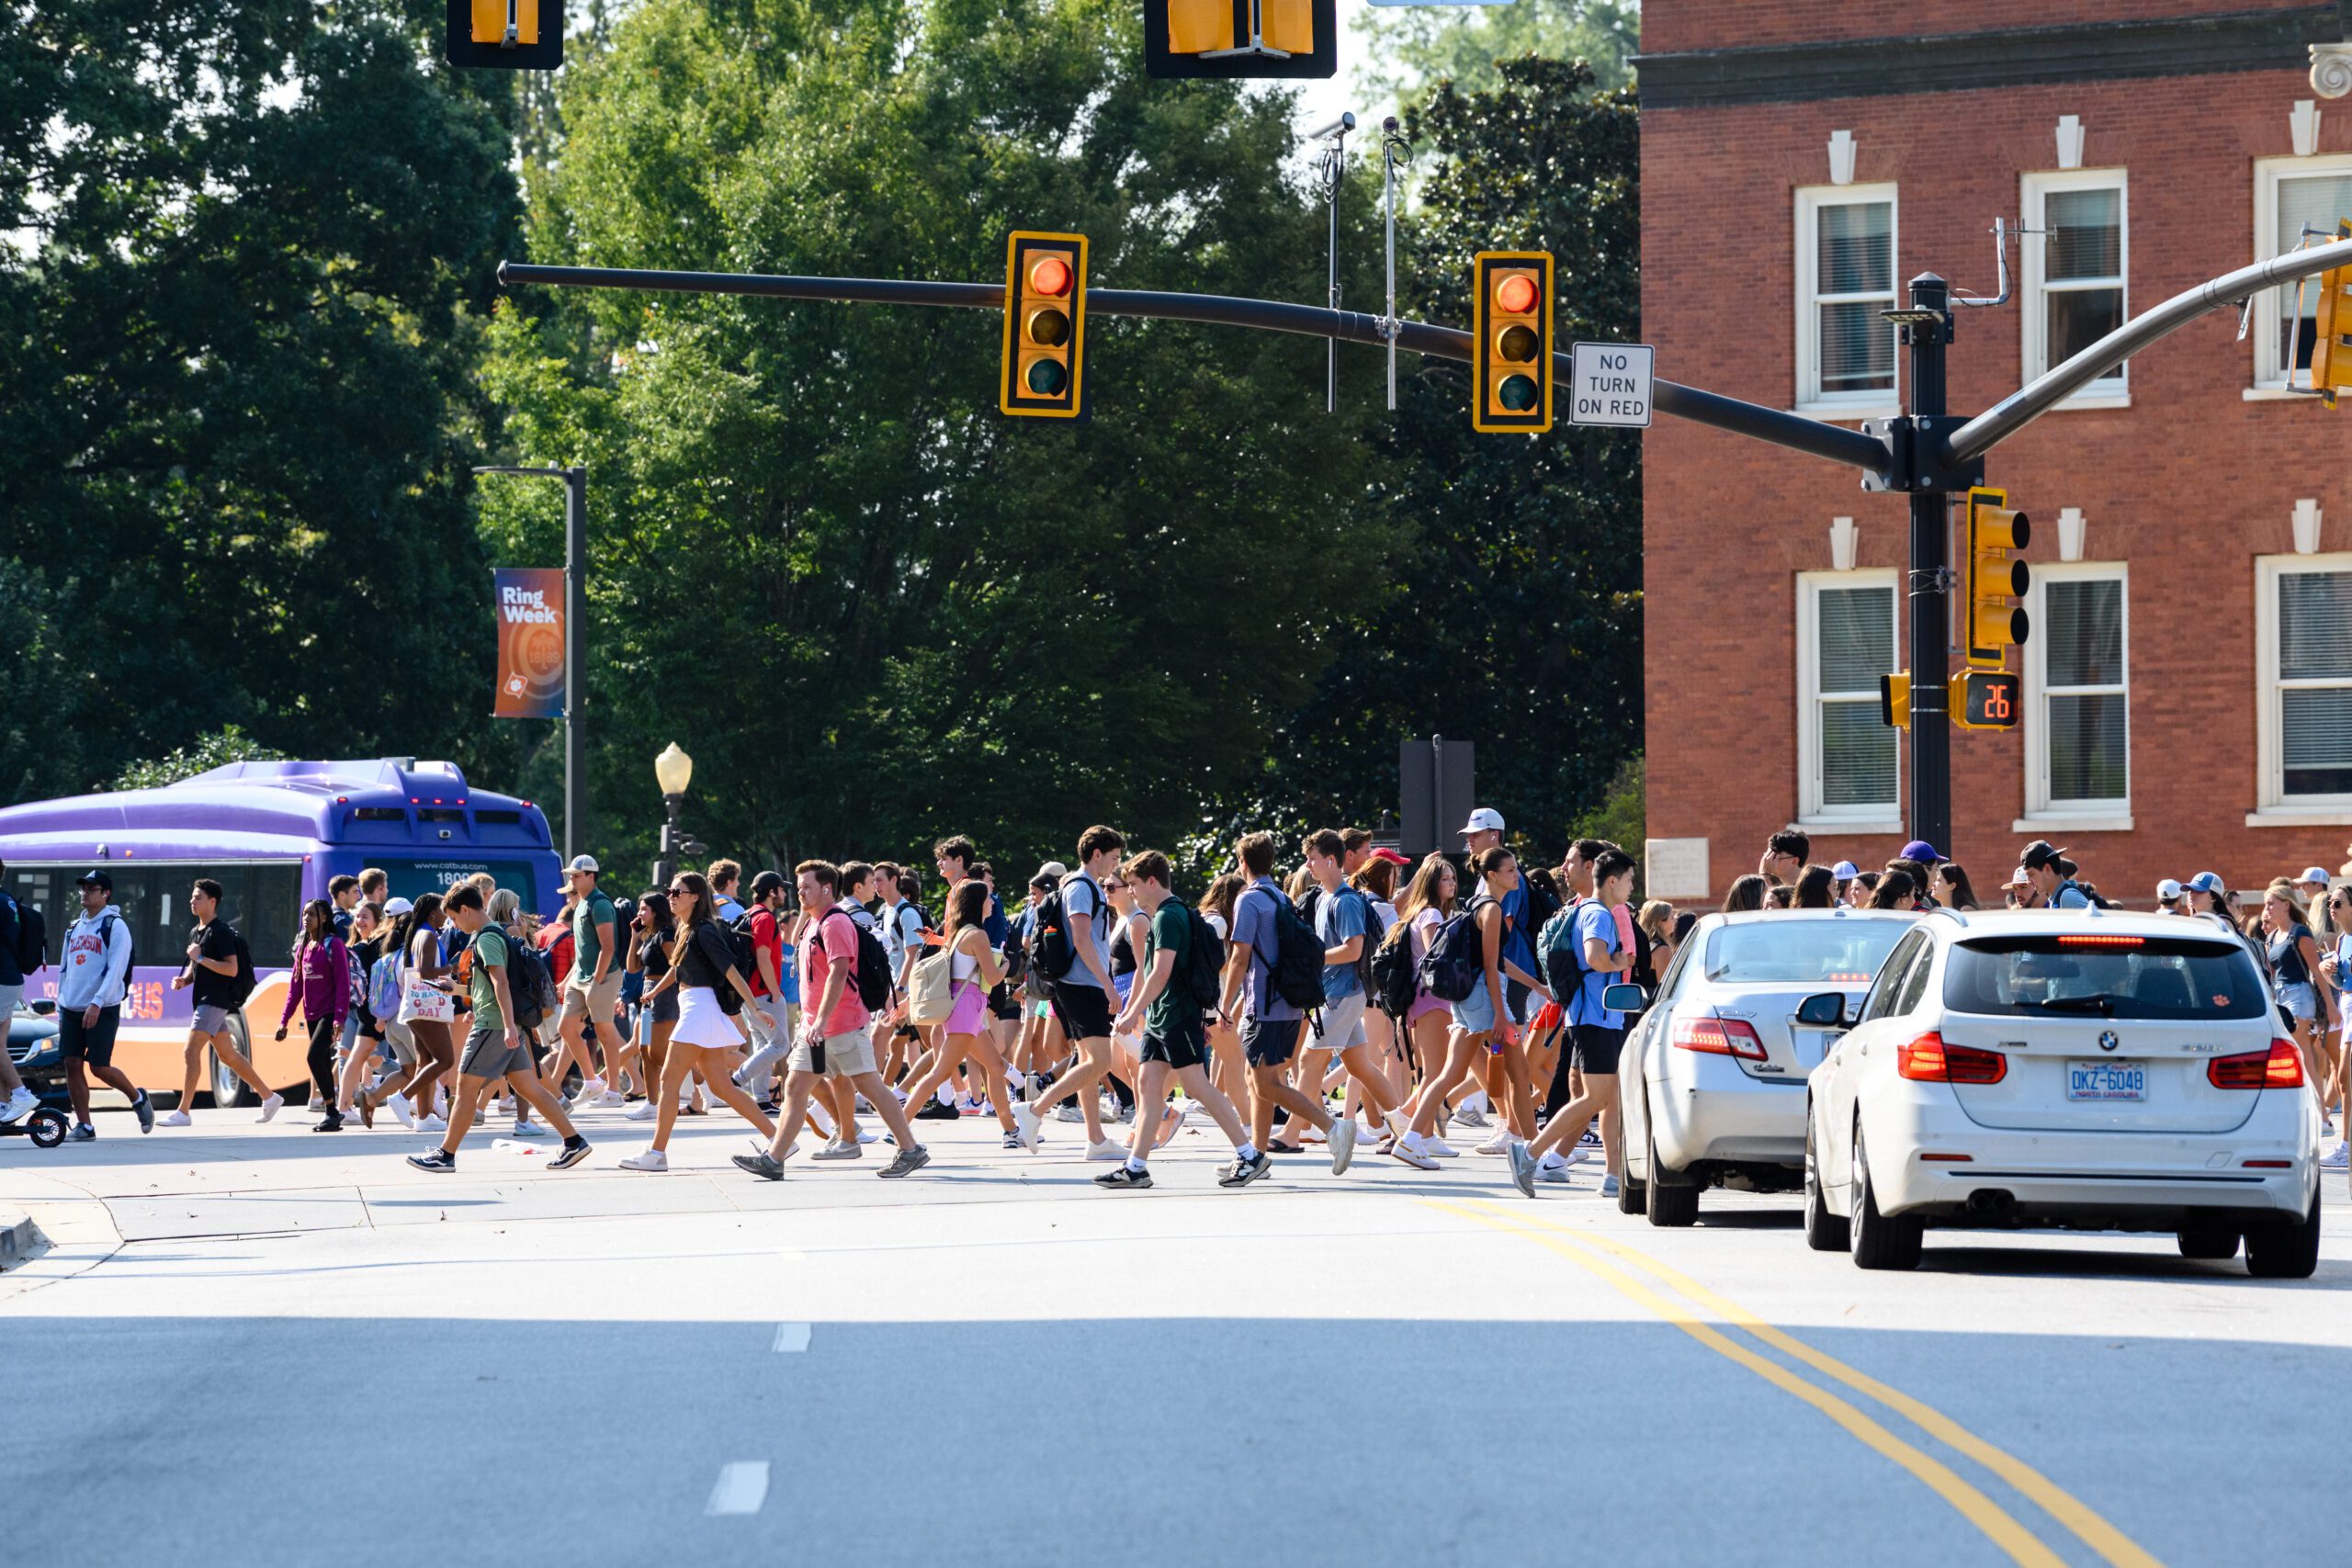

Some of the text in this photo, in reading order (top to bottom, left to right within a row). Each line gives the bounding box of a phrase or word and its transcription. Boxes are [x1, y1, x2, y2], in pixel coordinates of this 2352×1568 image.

[1600, 355, 1627, 370] NO
[1589, 377, 1635, 393] TURN
[1578, 399, 1644, 416] ON RED
[502, 586, 545, 609] Ring
[504, 605, 557, 624] Week
[1984, 684, 2009, 718] 26
[413, 863, 488, 871] www.catbus.com
[417, 1007, 442, 1017] DAY
[2072, 1071, 2143, 1090] DKZ-6048
[2103, 1090, 2139, 1099] CAROLINA
